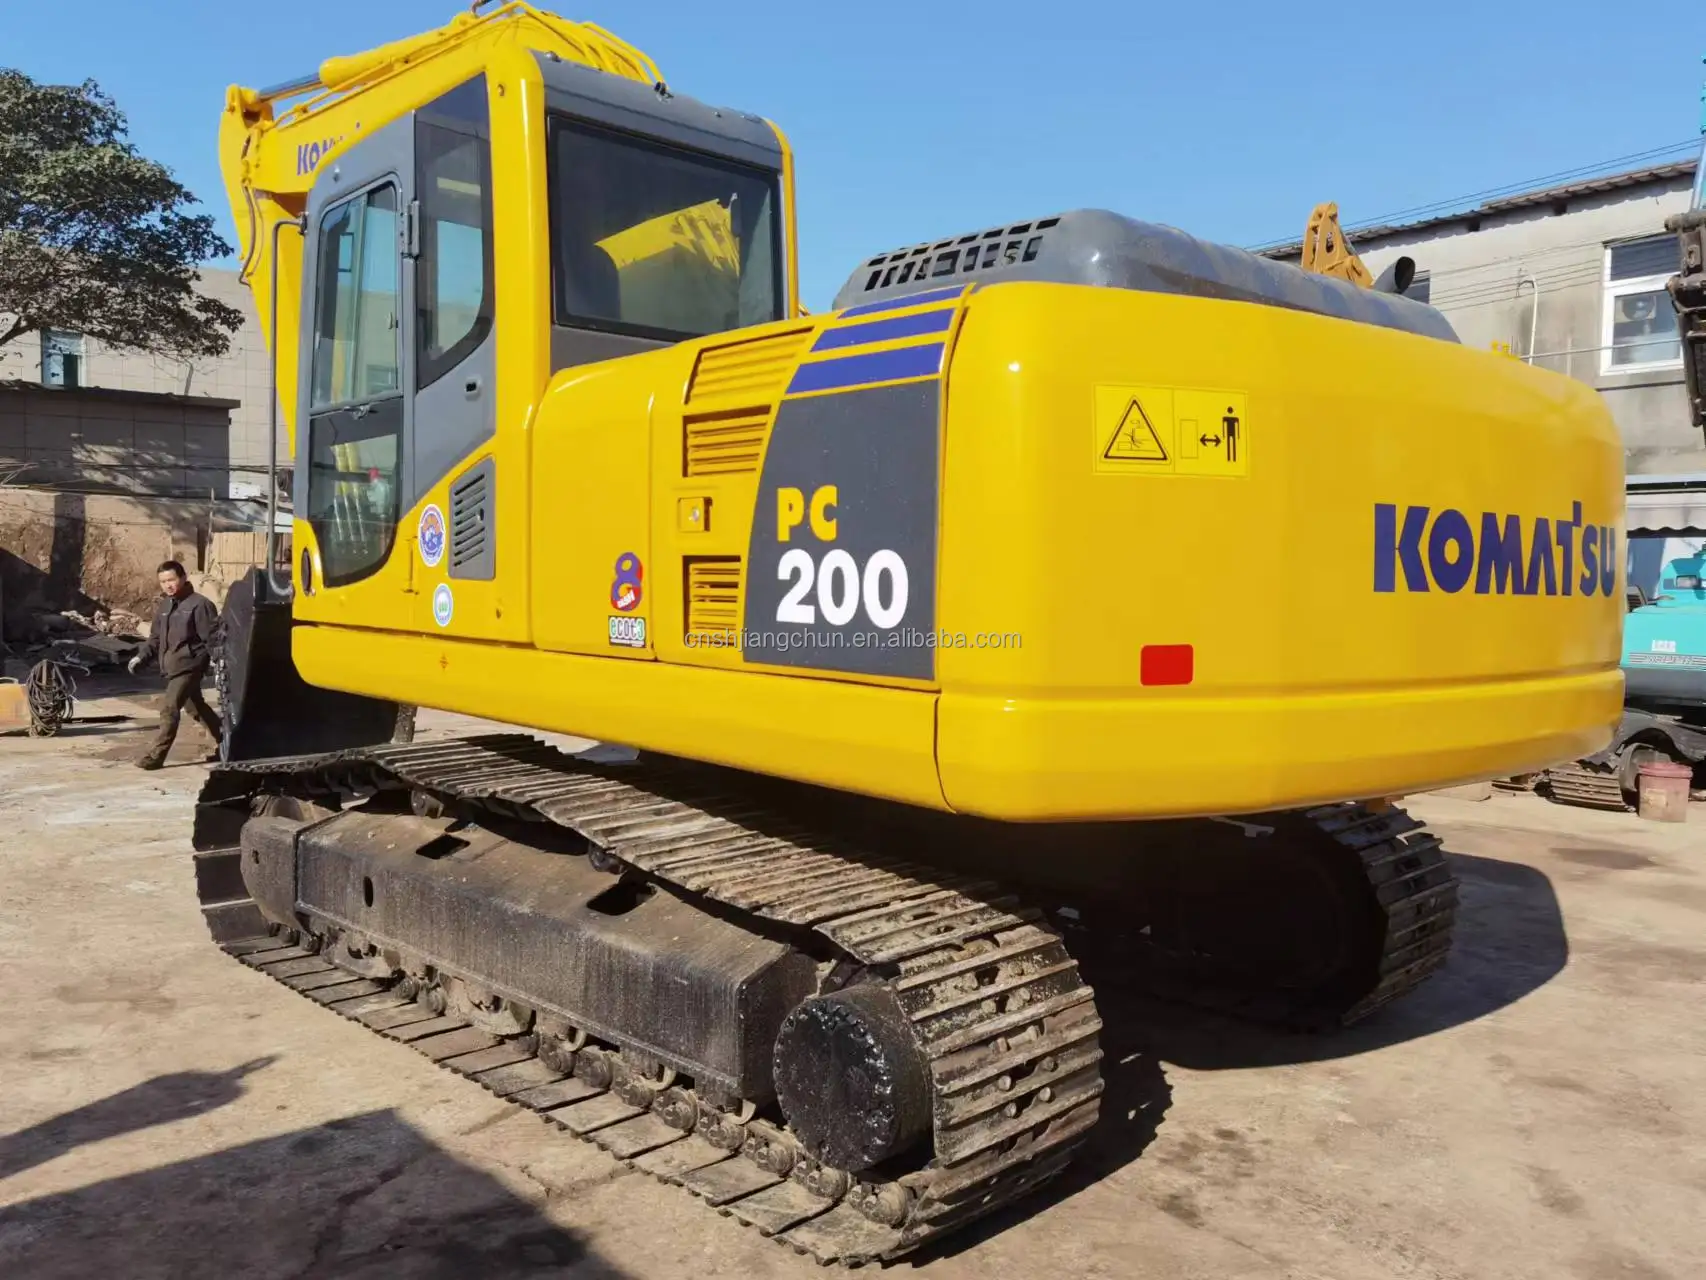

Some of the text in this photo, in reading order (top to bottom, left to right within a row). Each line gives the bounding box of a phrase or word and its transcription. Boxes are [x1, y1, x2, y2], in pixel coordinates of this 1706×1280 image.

[776, 485, 838, 543] PC
[1374, 500, 1615, 597] KOMATSU
[776, 549, 909, 629] 200
